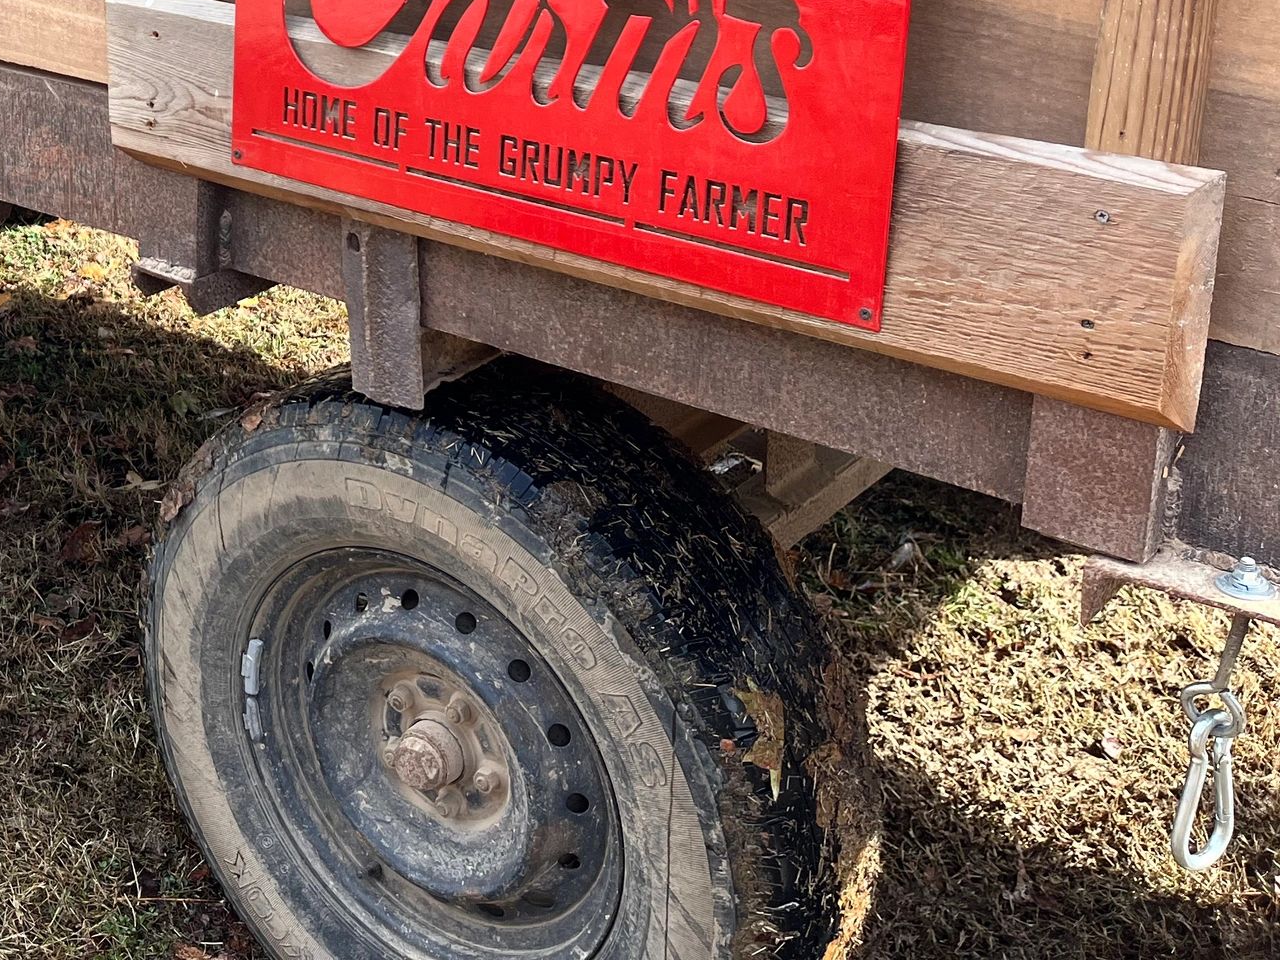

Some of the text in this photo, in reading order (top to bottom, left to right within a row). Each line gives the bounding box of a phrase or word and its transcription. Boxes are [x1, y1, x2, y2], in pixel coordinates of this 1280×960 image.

[282, 86, 810, 246] HOME OF THE GRUMPY FARMER
